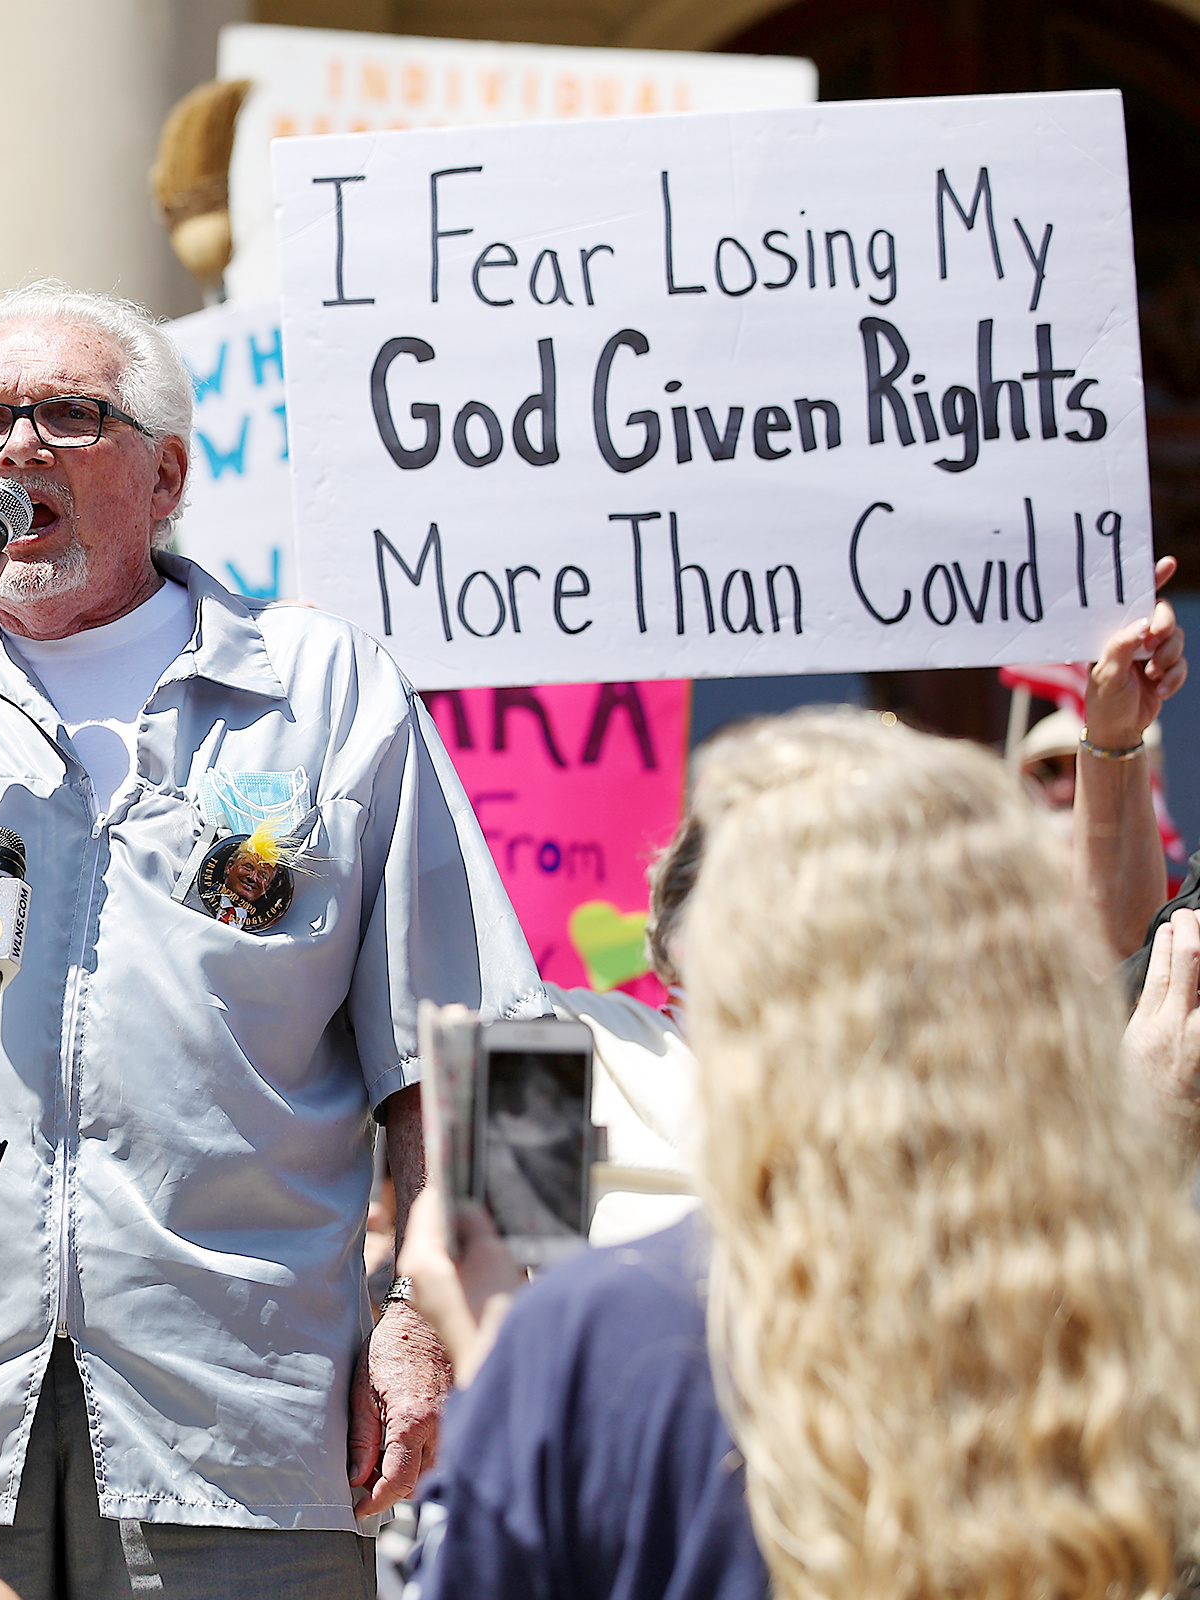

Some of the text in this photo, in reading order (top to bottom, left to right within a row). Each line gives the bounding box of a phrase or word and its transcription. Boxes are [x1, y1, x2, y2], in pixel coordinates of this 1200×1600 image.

[312, 166, 1054, 312] I Fear Losing My
[369, 316, 1108, 474] God Given Rights
[373, 497, 1125, 642] More Than Covid 19
[475, 792, 607, 884] From
[12, 888, 30, 959] WLNS.COM
